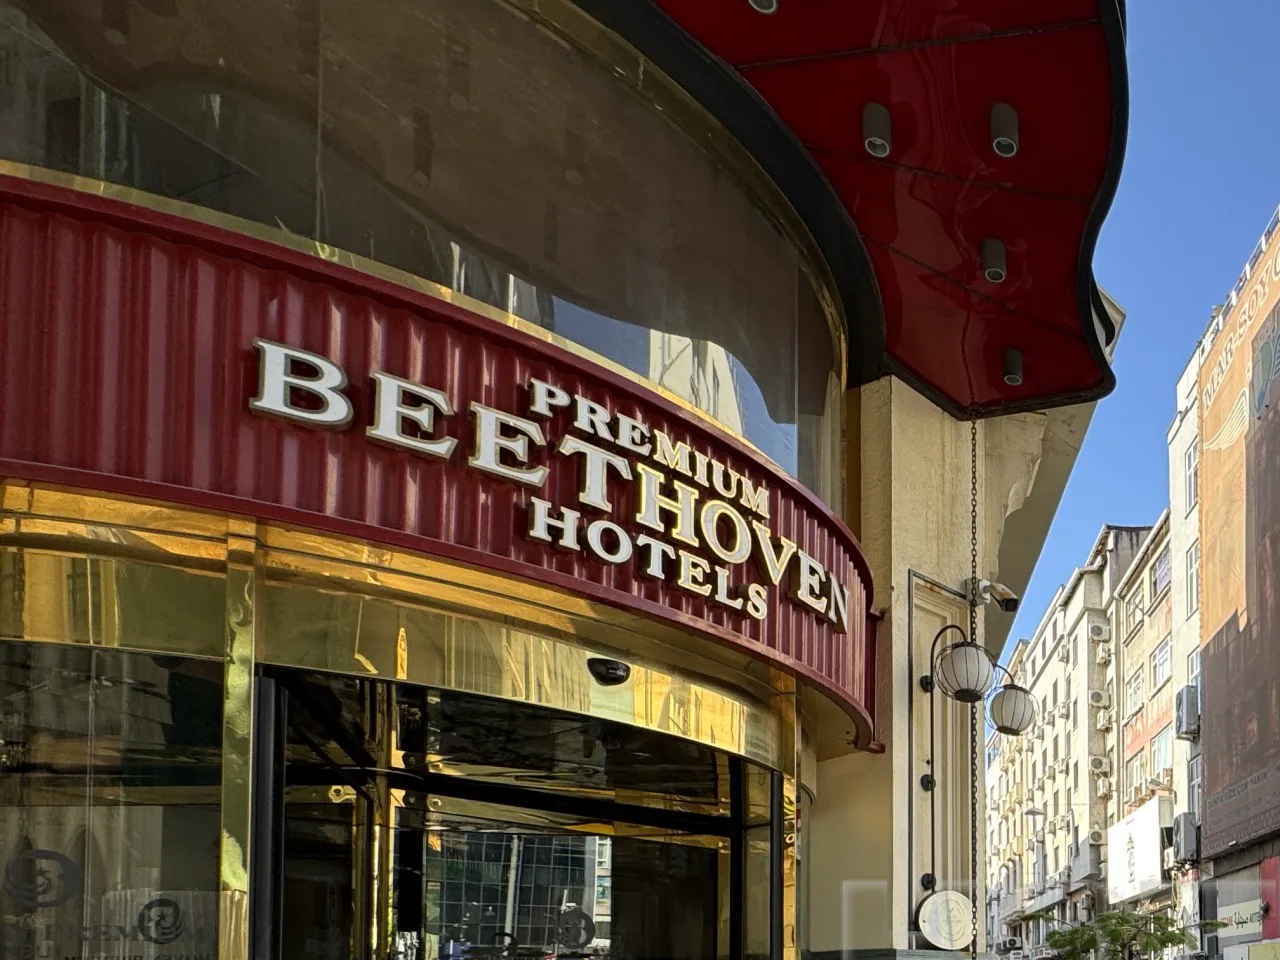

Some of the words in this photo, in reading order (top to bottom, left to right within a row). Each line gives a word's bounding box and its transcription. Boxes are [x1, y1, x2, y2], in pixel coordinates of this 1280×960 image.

[250, 338, 850, 634] BEETHOVEN
[529, 378, 771, 519] PREMIUM
[528, 496, 769, 620] HOTELS
